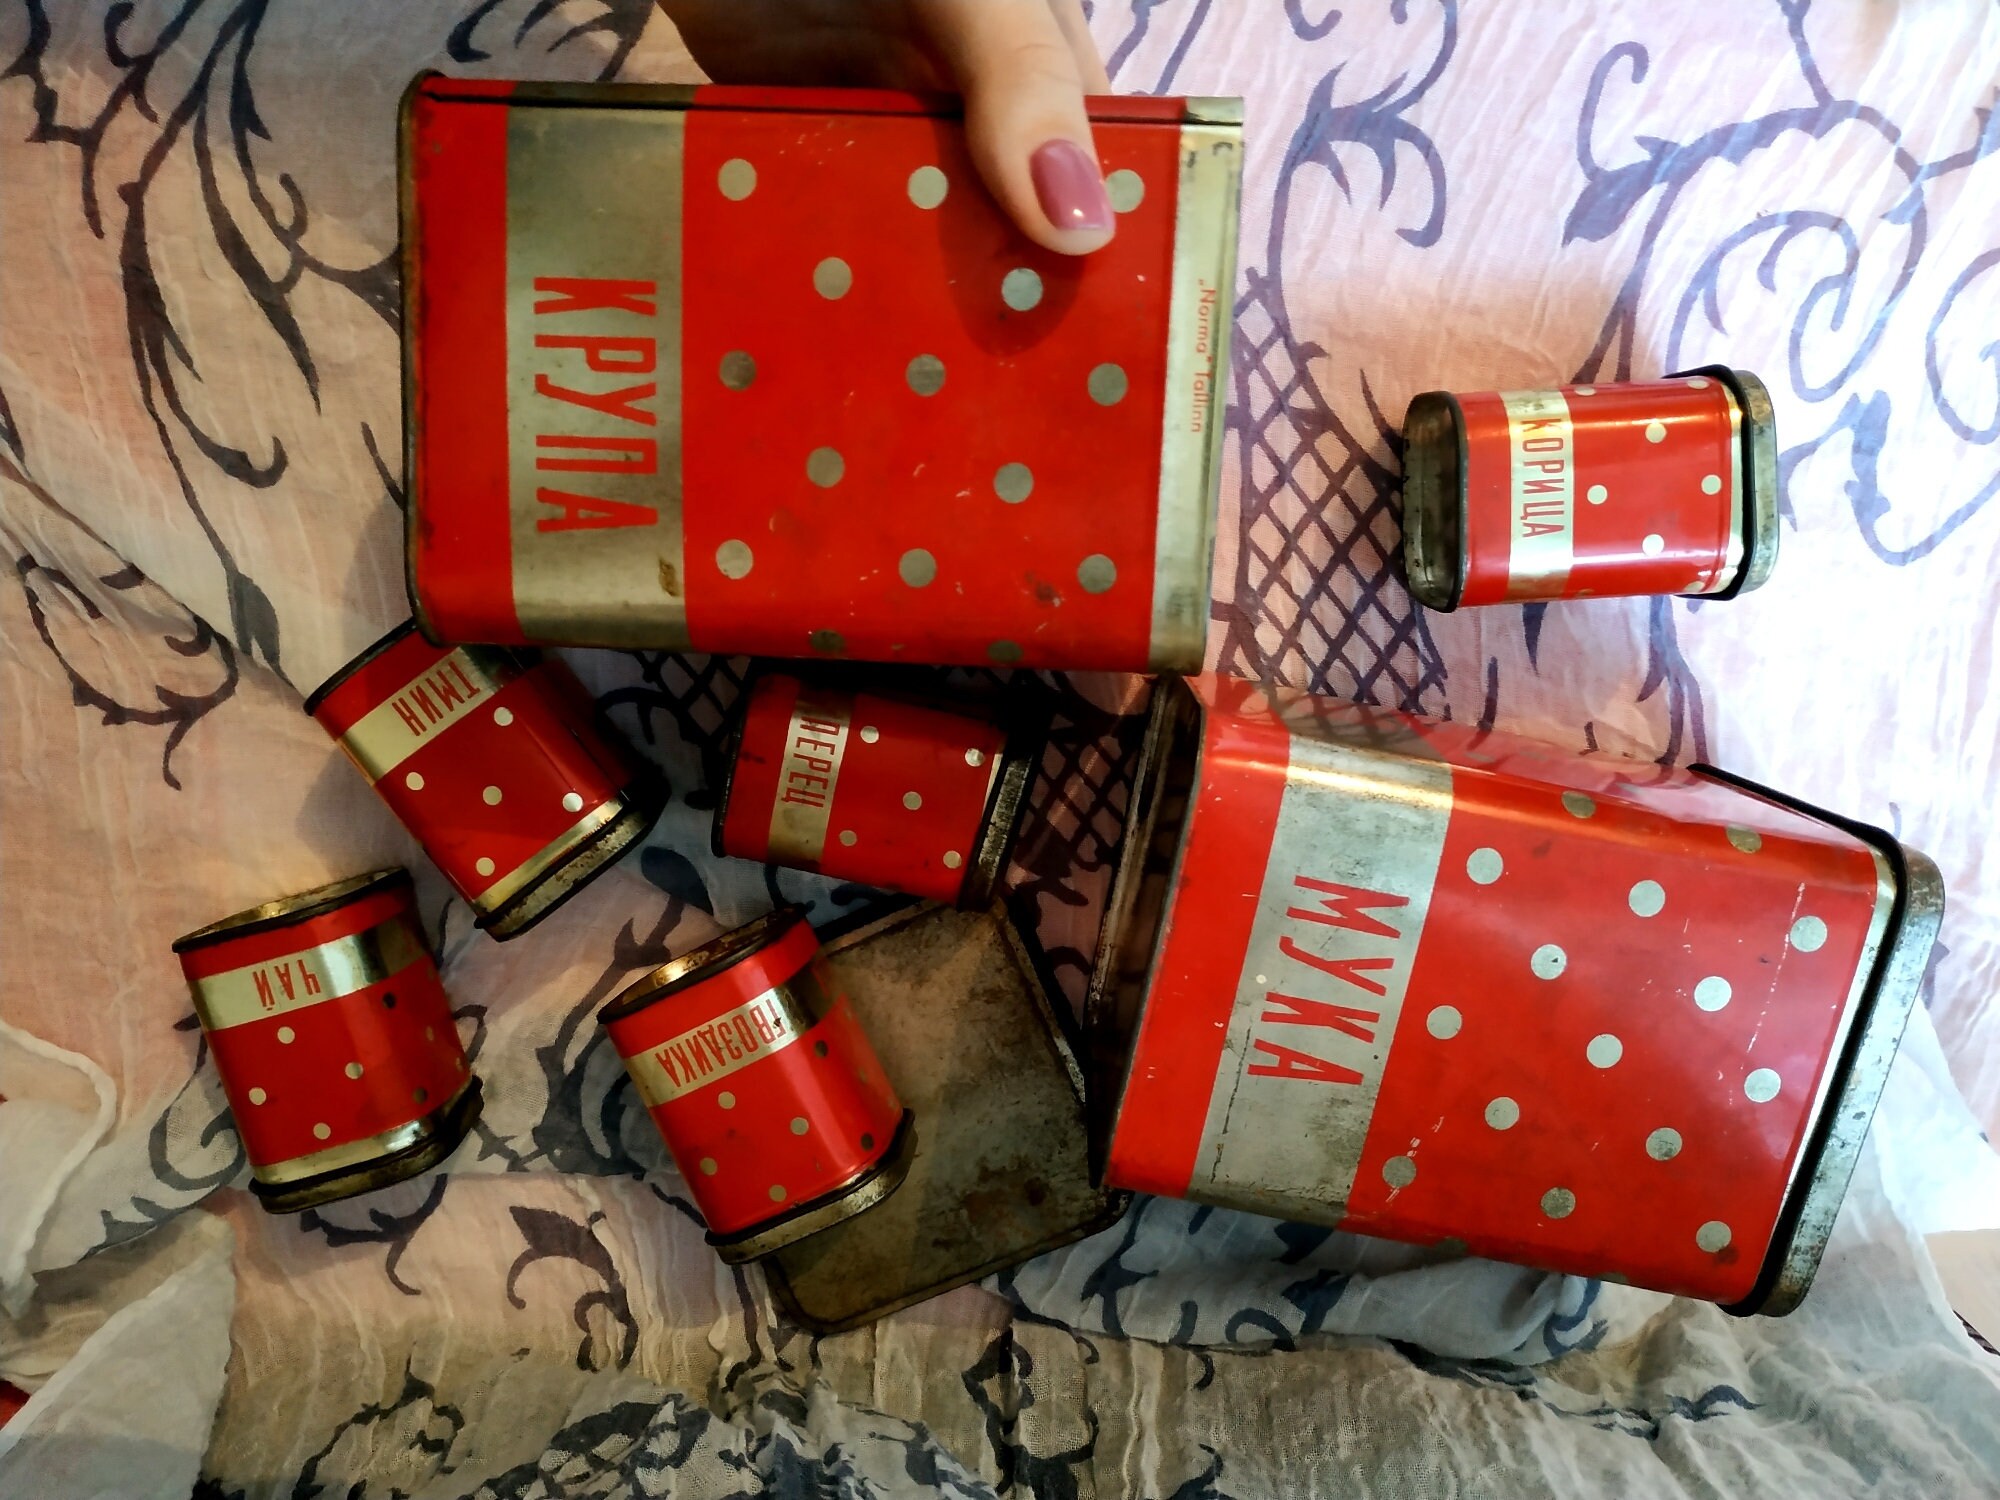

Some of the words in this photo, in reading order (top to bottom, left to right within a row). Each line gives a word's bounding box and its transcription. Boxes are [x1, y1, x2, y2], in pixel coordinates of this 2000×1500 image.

[533, 277, 658, 533] КРУПА
[1191, 370, 1212, 433] Tallinn
[1520, 418, 1565, 538] КОРИЦА
[393, 659, 481, 736] ТМИН
[781, 716, 841, 808] ПЕРЕЦ
[252, 959, 321, 1011] ЧАЙ
[1247, 875, 1411, 1085] МУКА
[657, 997, 788, 1088] ГВОЗДИКА
